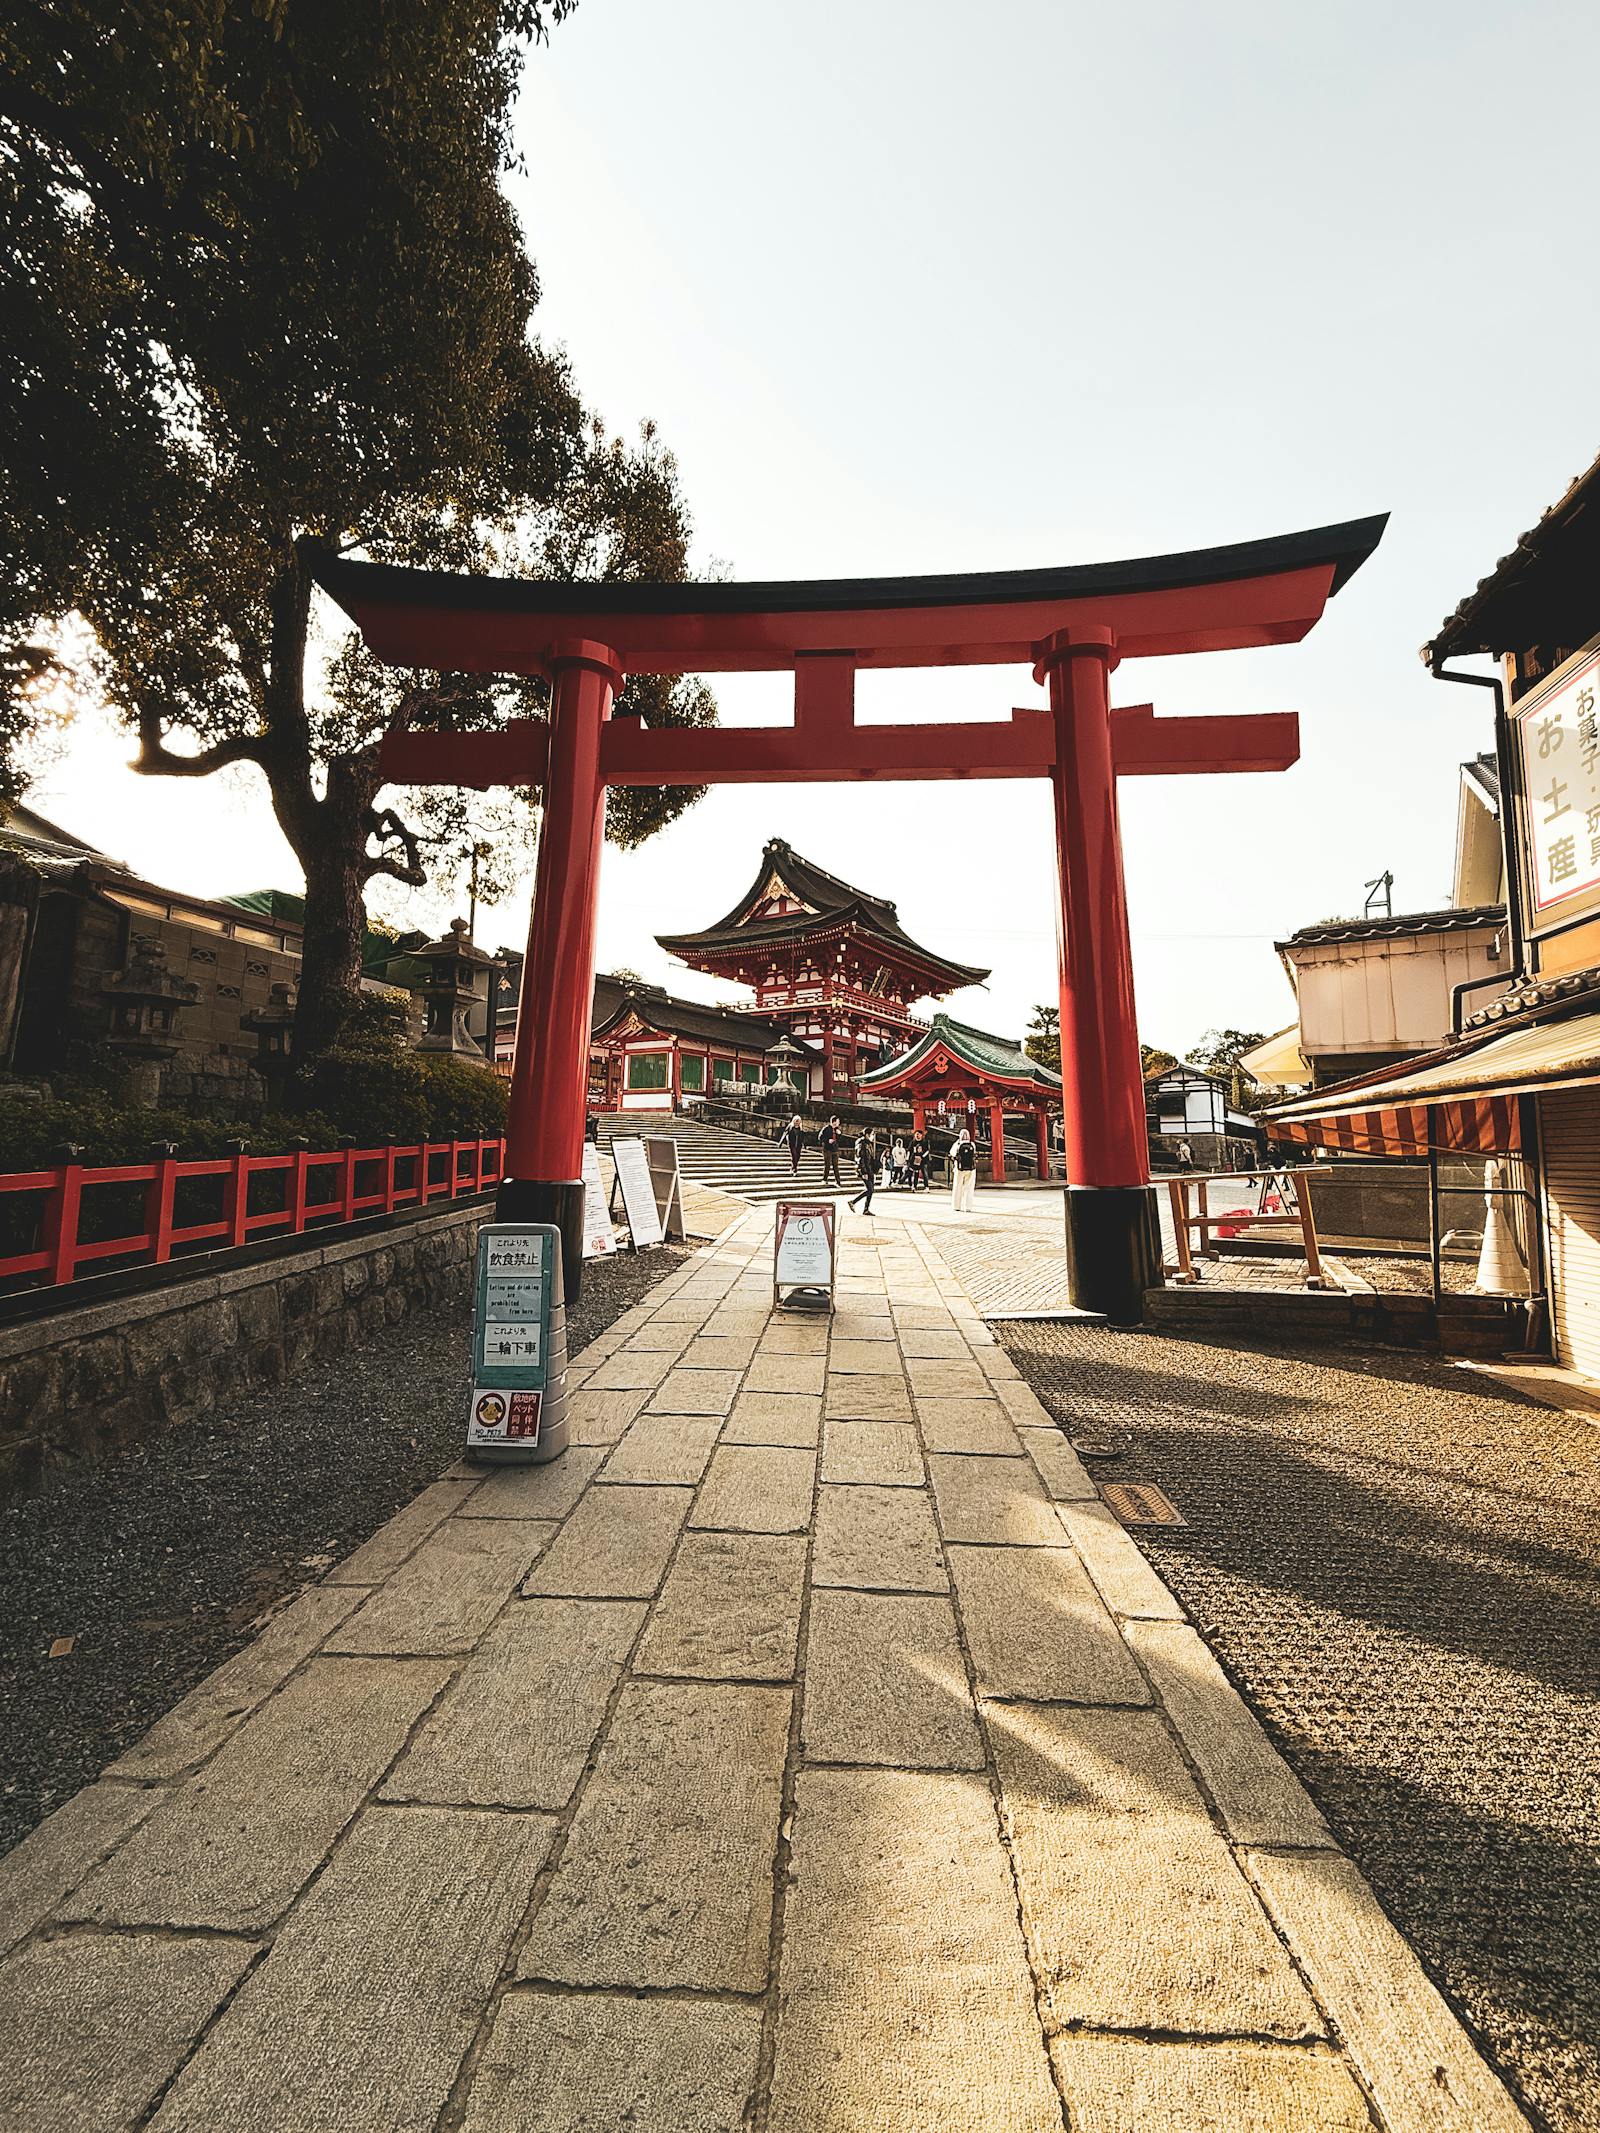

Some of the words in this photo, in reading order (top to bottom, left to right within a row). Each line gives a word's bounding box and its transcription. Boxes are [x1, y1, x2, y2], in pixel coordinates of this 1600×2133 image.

[1538, 714, 1577, 885] お土産
[497, 1239, 529, 1247] これより先
[490, 1252, 539, 1266] 飲食禁止
[494, 1327, 527, 1336] これより先
[486, 1341, 537, 1355] 二輪下車
[513, 1404, 534, 1413] ペット
